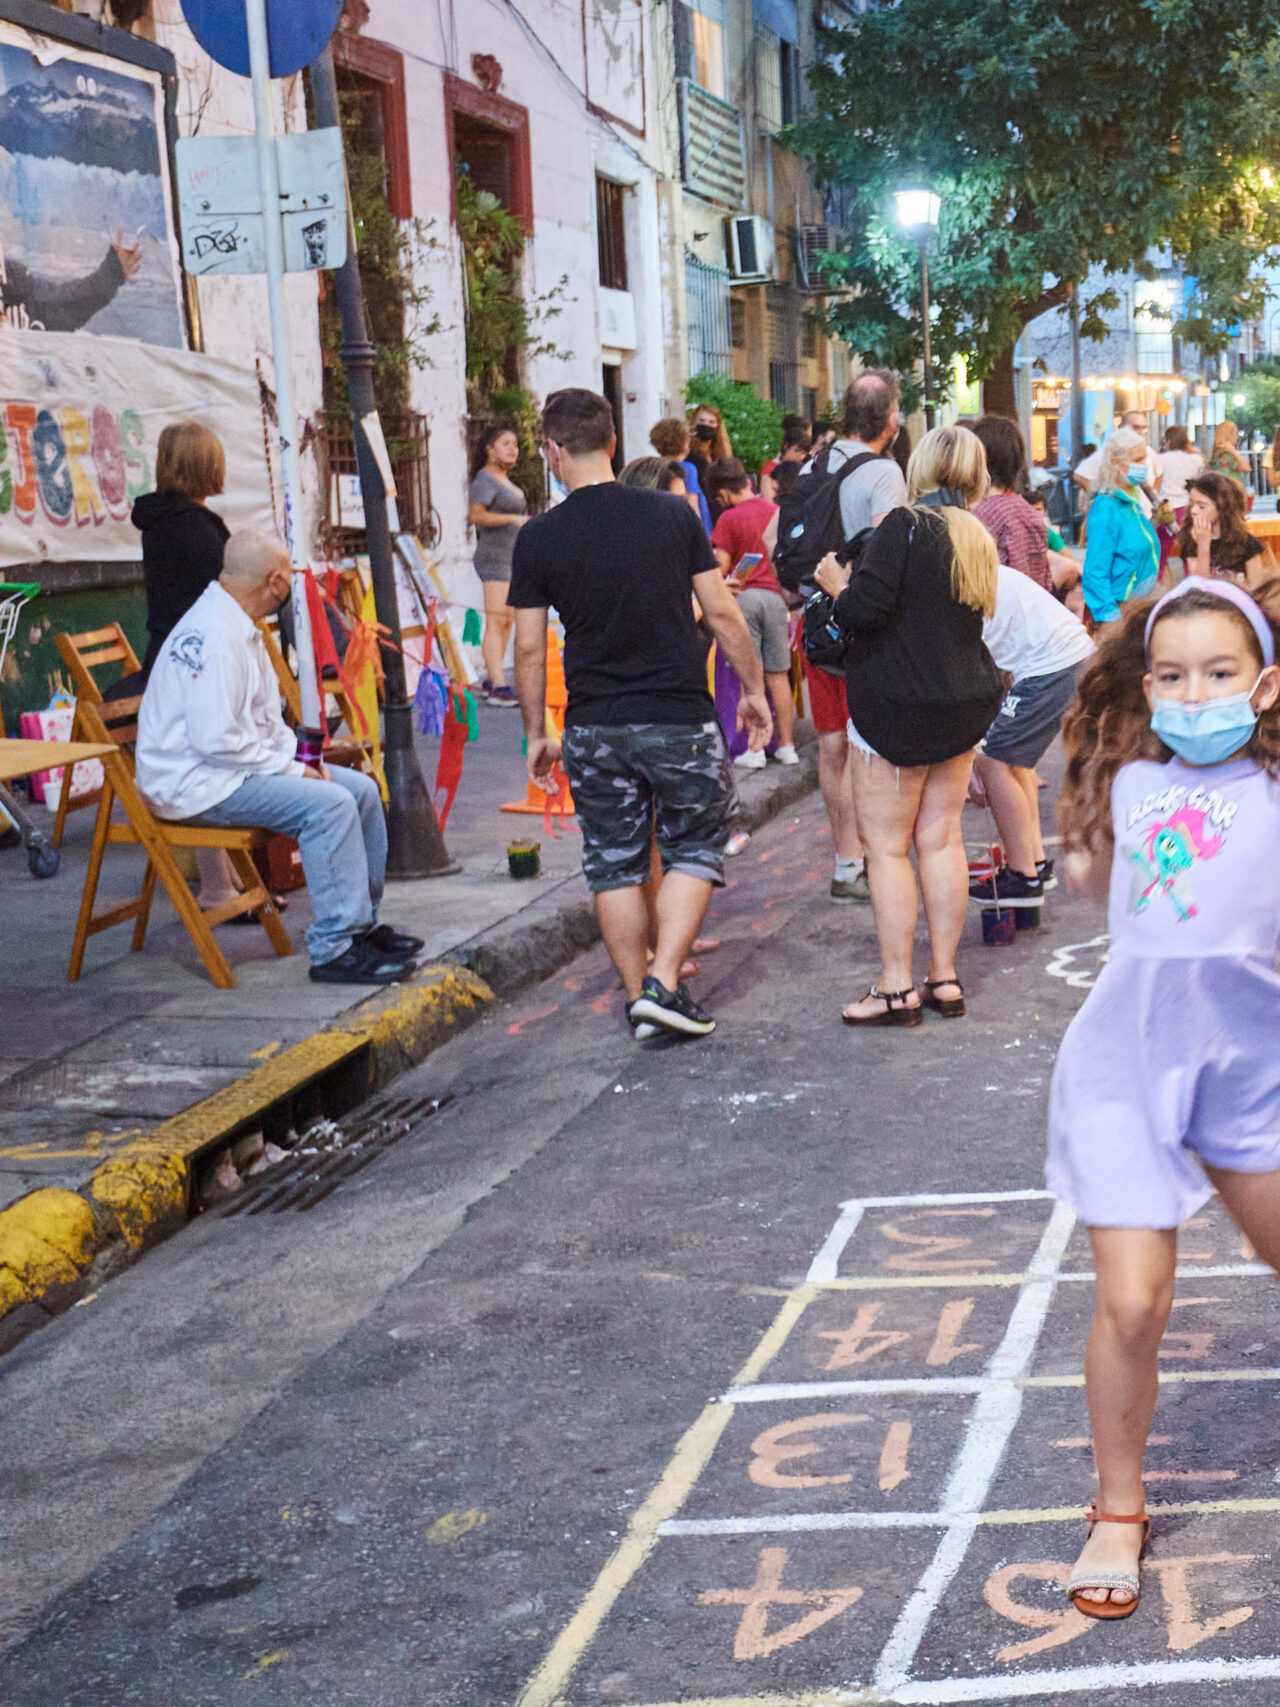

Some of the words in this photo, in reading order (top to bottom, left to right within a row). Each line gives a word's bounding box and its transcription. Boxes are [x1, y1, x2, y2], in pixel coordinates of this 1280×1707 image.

[817, 1297, 984, 1371] 14
[748, 1411, 914, 1494] 13
[696, 1546, 864, 1661] 4
